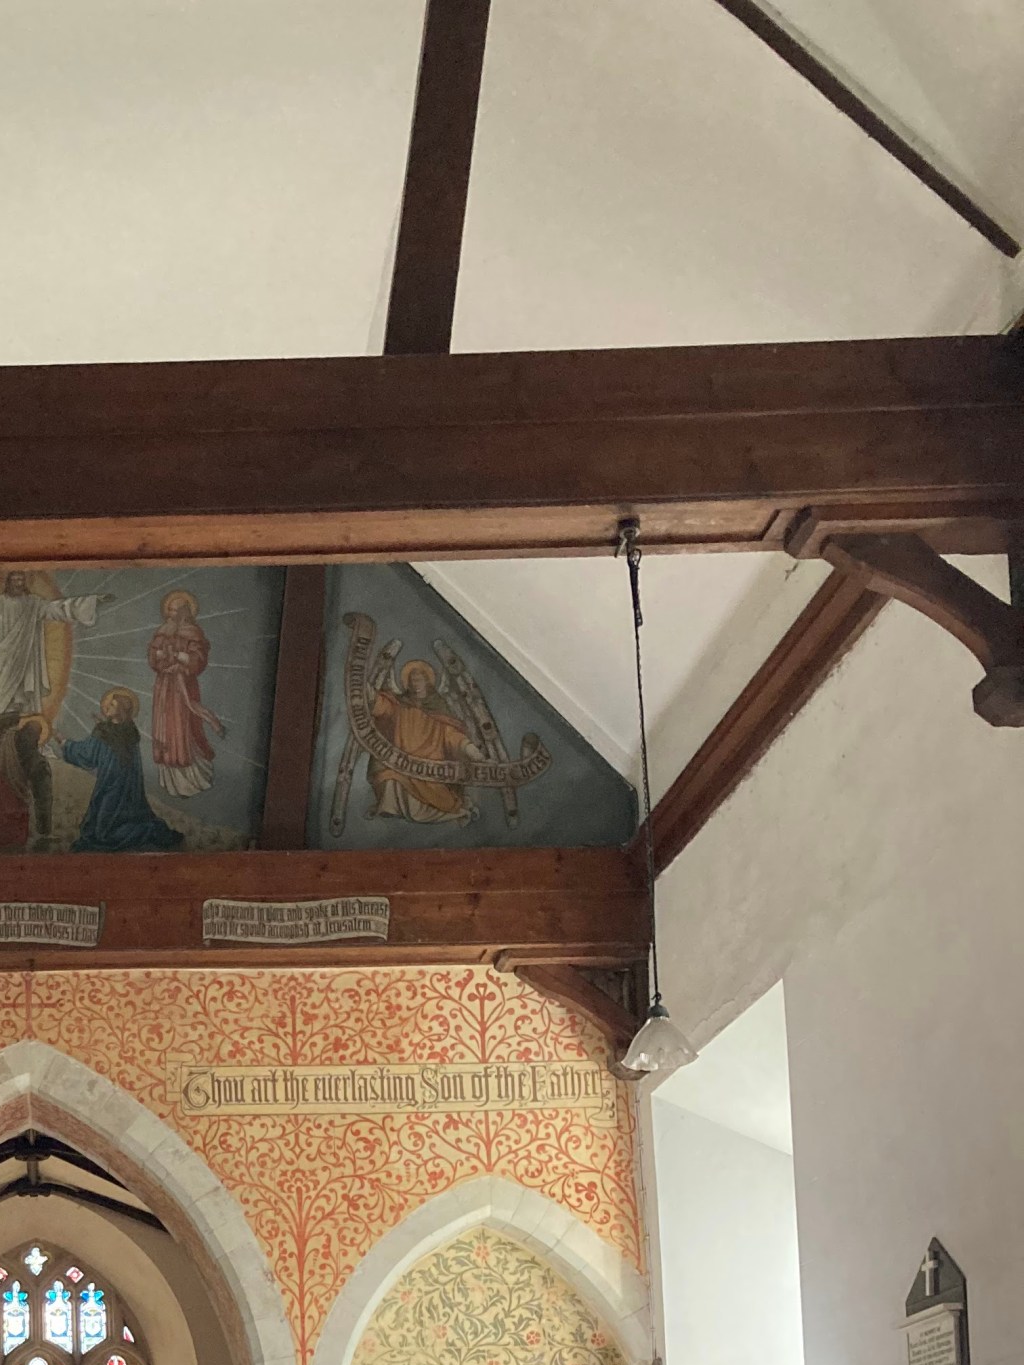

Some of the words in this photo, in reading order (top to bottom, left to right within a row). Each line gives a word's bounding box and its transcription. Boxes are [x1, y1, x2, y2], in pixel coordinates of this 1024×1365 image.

[183, 1069, 245, 1109] Thou
[250, 1068, 279, 1103] art
[283, 1068, 310, 1110] the
[420, 1066, 466, 1106] Son
[471, 1066, 494, 1107] of
[495, 1065, 527, 1106] the
[527, 1065, 600, 1103] Father
